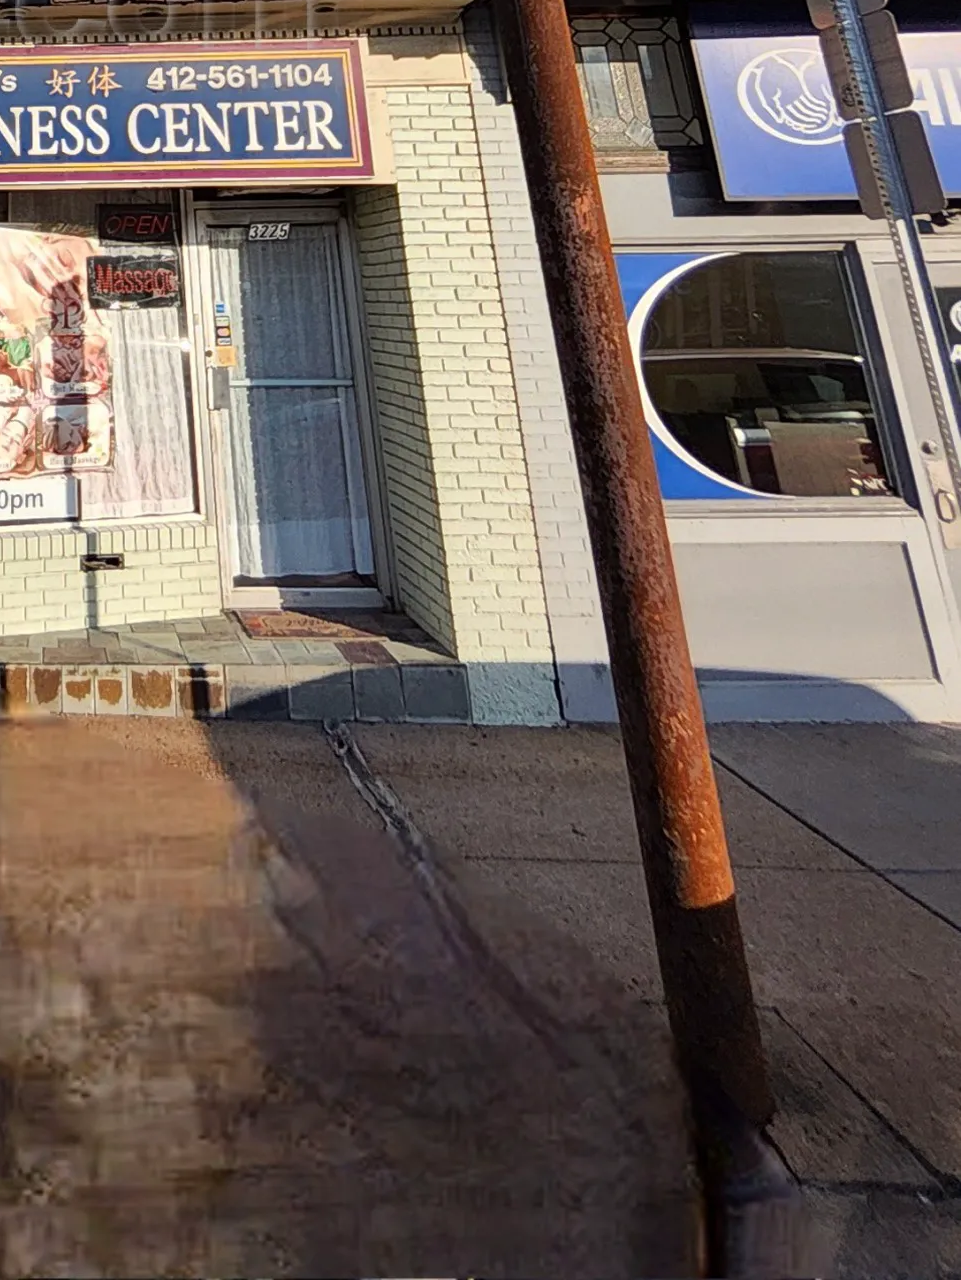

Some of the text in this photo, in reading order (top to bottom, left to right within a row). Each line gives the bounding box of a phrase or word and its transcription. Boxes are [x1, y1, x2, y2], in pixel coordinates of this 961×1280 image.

[146, 63, 333, 91] 412-561-1104
[127, 100, 343, 154] CENTER
[105, 214, 169, 235] OPEN
[249, 223, 289, 240] 3225
[95, 263, 178, 297] Massage
